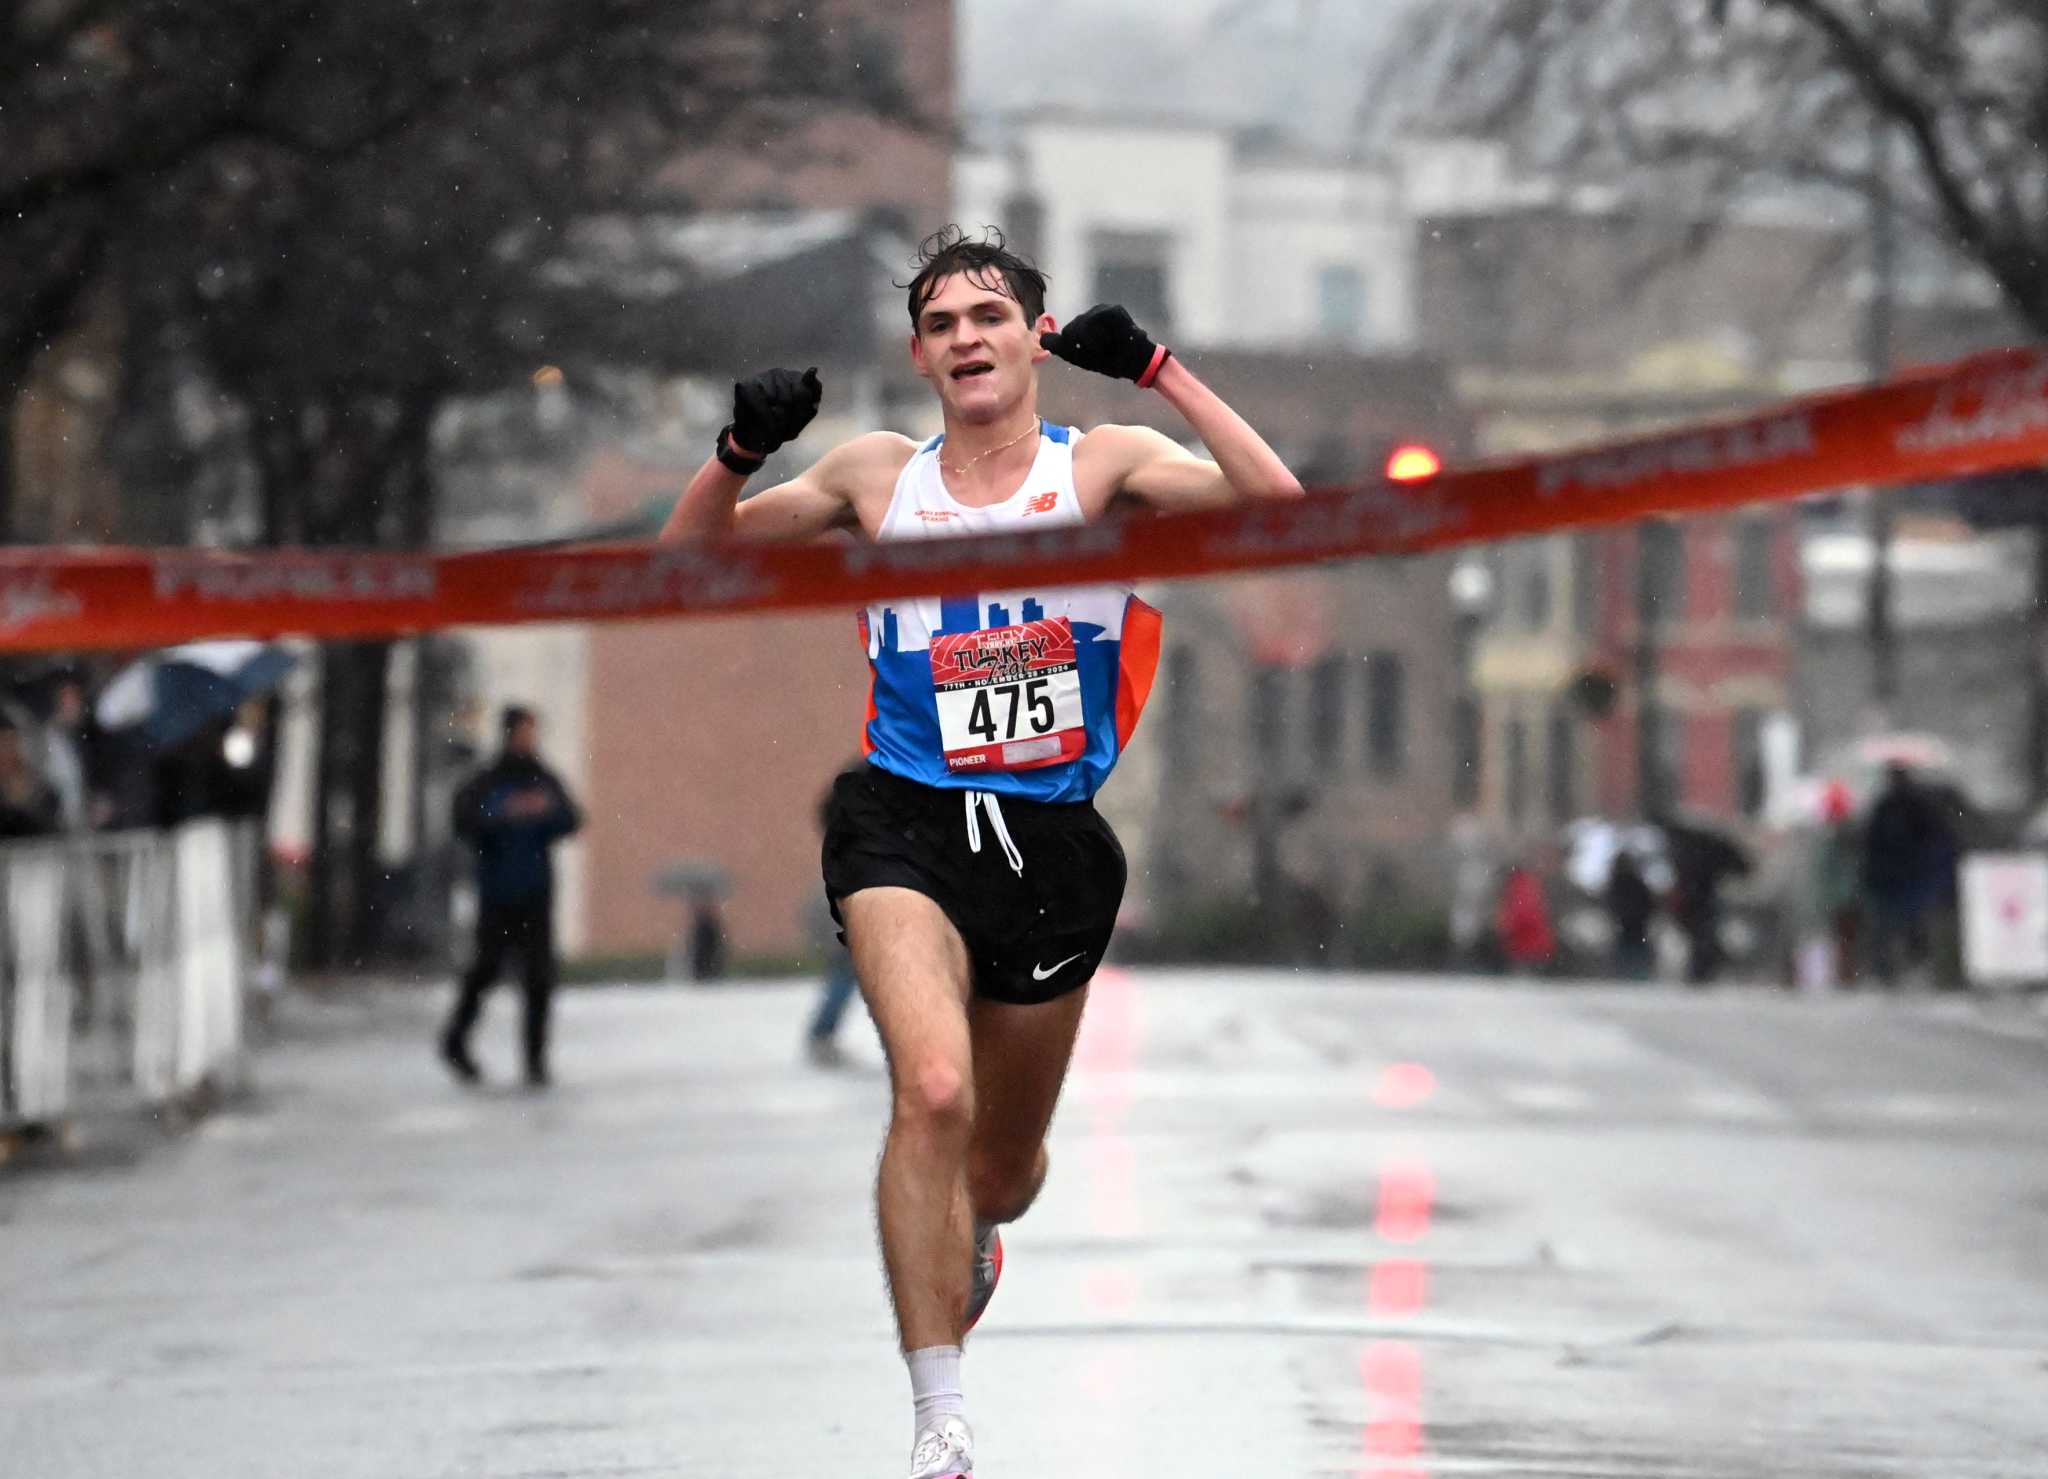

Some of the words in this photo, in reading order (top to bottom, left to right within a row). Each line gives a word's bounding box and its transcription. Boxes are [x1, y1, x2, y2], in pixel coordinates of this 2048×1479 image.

[953, 636, 1048, 672] TURKEY
[943, 682, 966, 692] 77TH
[974, 673, 1025, 687] NOEMBER
[1047, 665, 1069, 676] 2024
[968, 678, 1055, 742] 475
[949, 753, 987, 767] PIONEER
